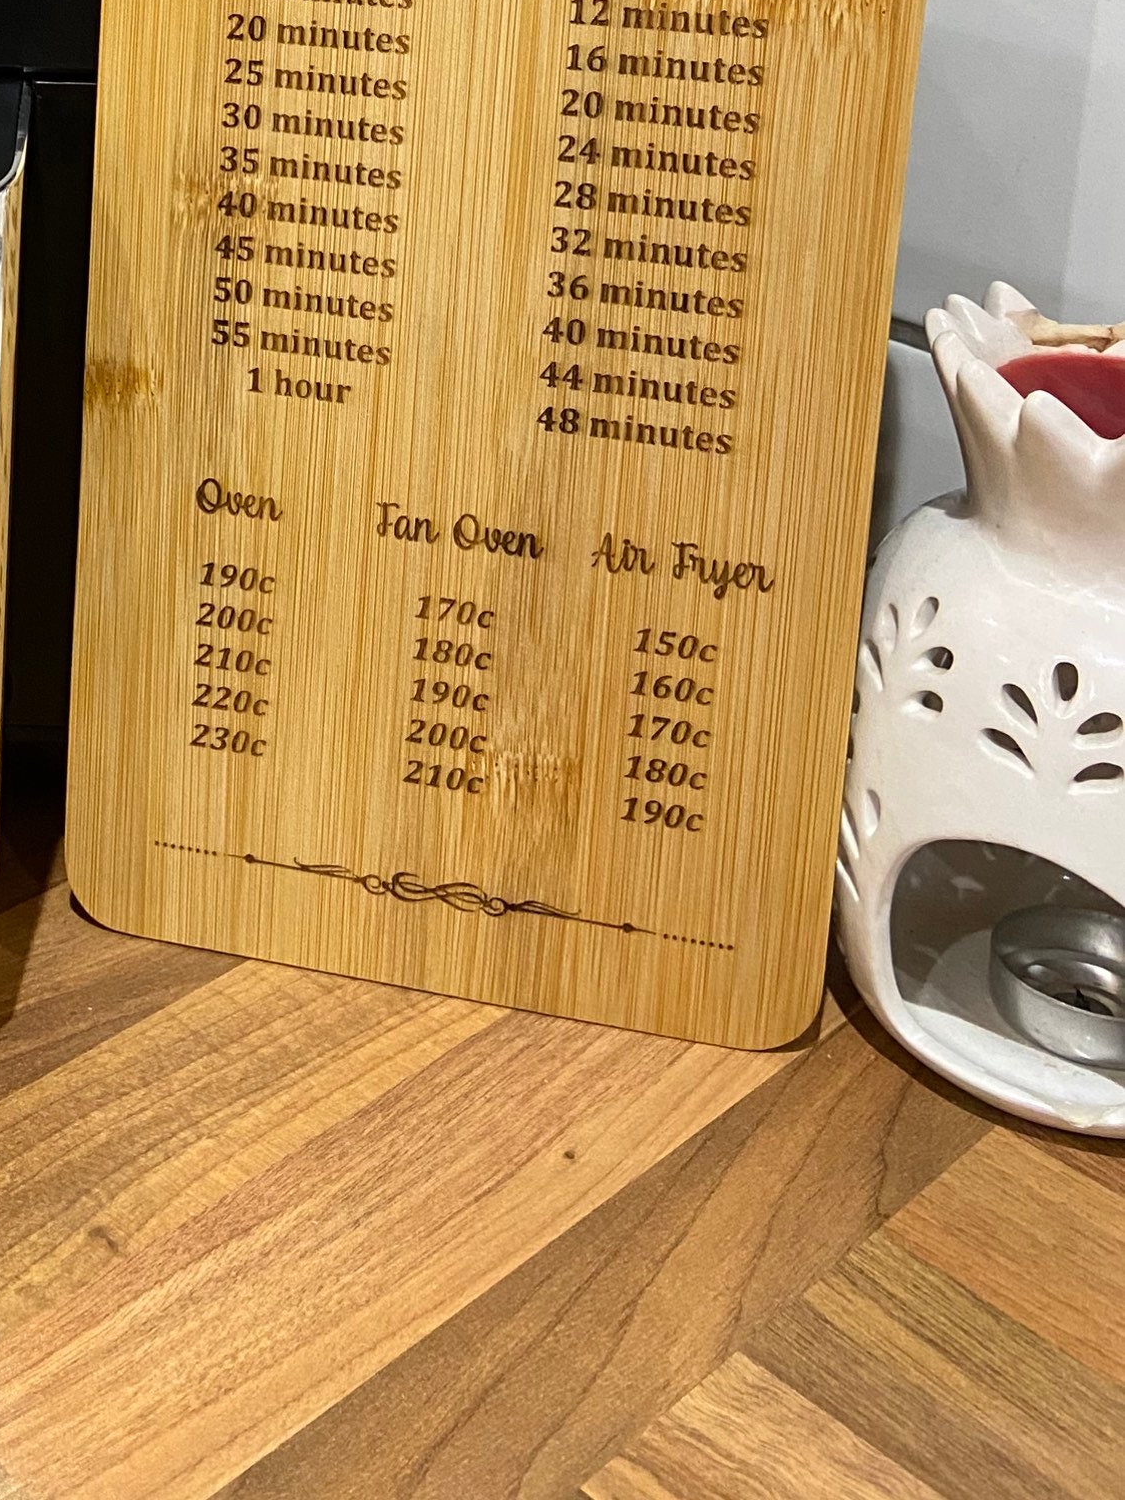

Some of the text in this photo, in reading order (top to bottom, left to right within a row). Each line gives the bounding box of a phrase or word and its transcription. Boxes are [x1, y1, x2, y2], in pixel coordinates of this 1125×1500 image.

[226, 13, 411, 55] 20 minutes
[621, 2, 771, 39] minutes
[223, 58, 409, 100] 25 minutes
[565, 44, 767, 87] 16 minutes
[221, 102, 405, 145] 30 minutes
[560, 88, 762, 134] 20 minutes
[219, 145, 403, 190] 35 minutes
[557, 134, 758, 181] 24 minutes
[216, 190, 400, 234] 40 minutes
[553, 180, 753, 227] 28 minutes
[213, 234, 397, 278] 45 minutes
[550, 226, 749, 273] 32 minutes
[213, 276, 395, 323] 50 minutes
[546, 271, 746, 319] 36 minutes
[210, 319, 393, 366] 55 minutes
[541, 316, 742, 365] 40 minutes
[247, 367, 353, 404] 1 hour
[539, 361, 737, 410] 44 minutes
[535, 406, 734, 455] 48 minutes
[195, 477, 282, 522] Oven
[375, 502, 546, 560] Fan Oven
[199, 562, 277, 594] 190c
[591, 533, 777, 600] Air Fryer
[195, 602, 275, 635] 200c
[414, 595, 496, 629] 170c
[193, 643, 273, 676] 210c
[412, 637, 493, 671] 180c
[632, 628, 720, 663] 150c
[191, 683, 270, 716] 220c
[409, 678, 491, 712] 190c
[629, 671, 716, 706] 160c
[189, 723, 268, 757] 230c
[404, 719, 489, 754] 200c
[626, 713, 713, 748] 170c
[402, 760, 485, 795] 210c
[623, 755, 709, 791] 180c
[620, 797, 706, 832] 190c
